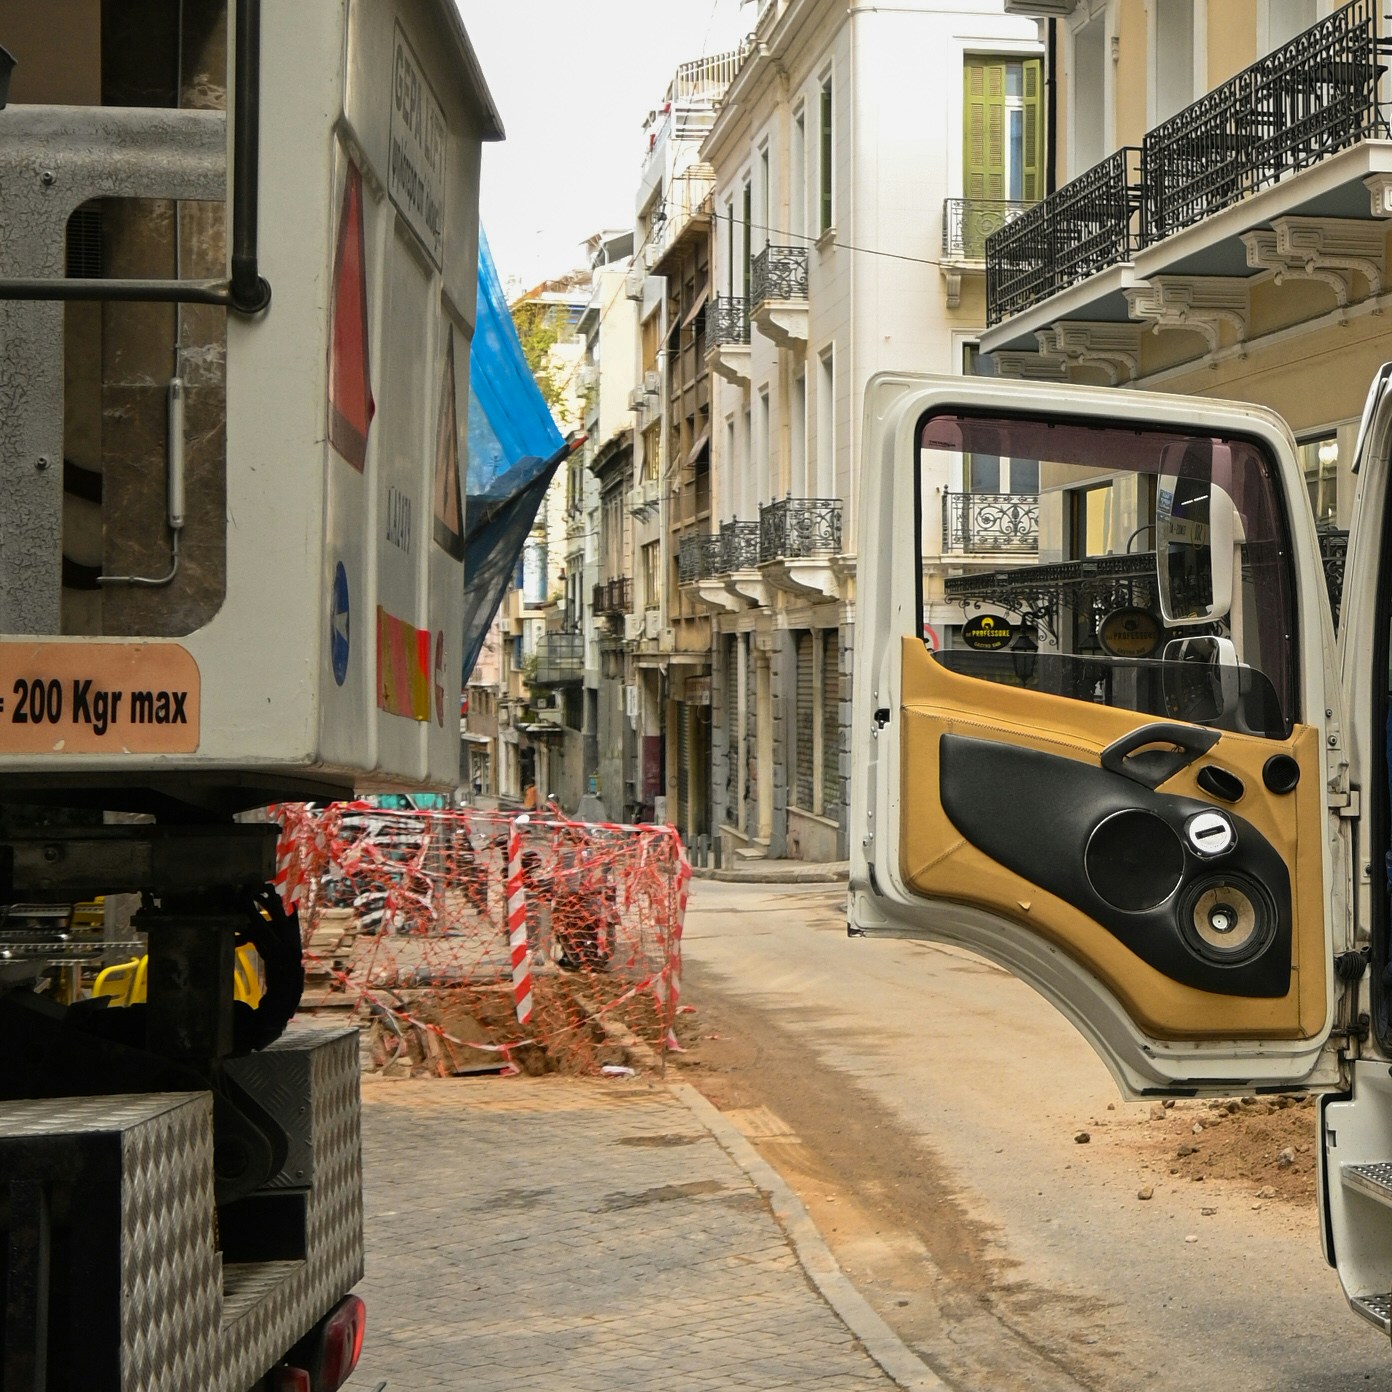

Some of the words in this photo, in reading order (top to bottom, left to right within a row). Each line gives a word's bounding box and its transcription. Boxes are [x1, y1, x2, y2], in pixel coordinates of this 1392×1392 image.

[972, 629, 1010, 637] PROFESSORE
[12, 678, 62, 724] 200
[72, 679, 122, 736] Kgr
[130, 691, 188, 724] max
